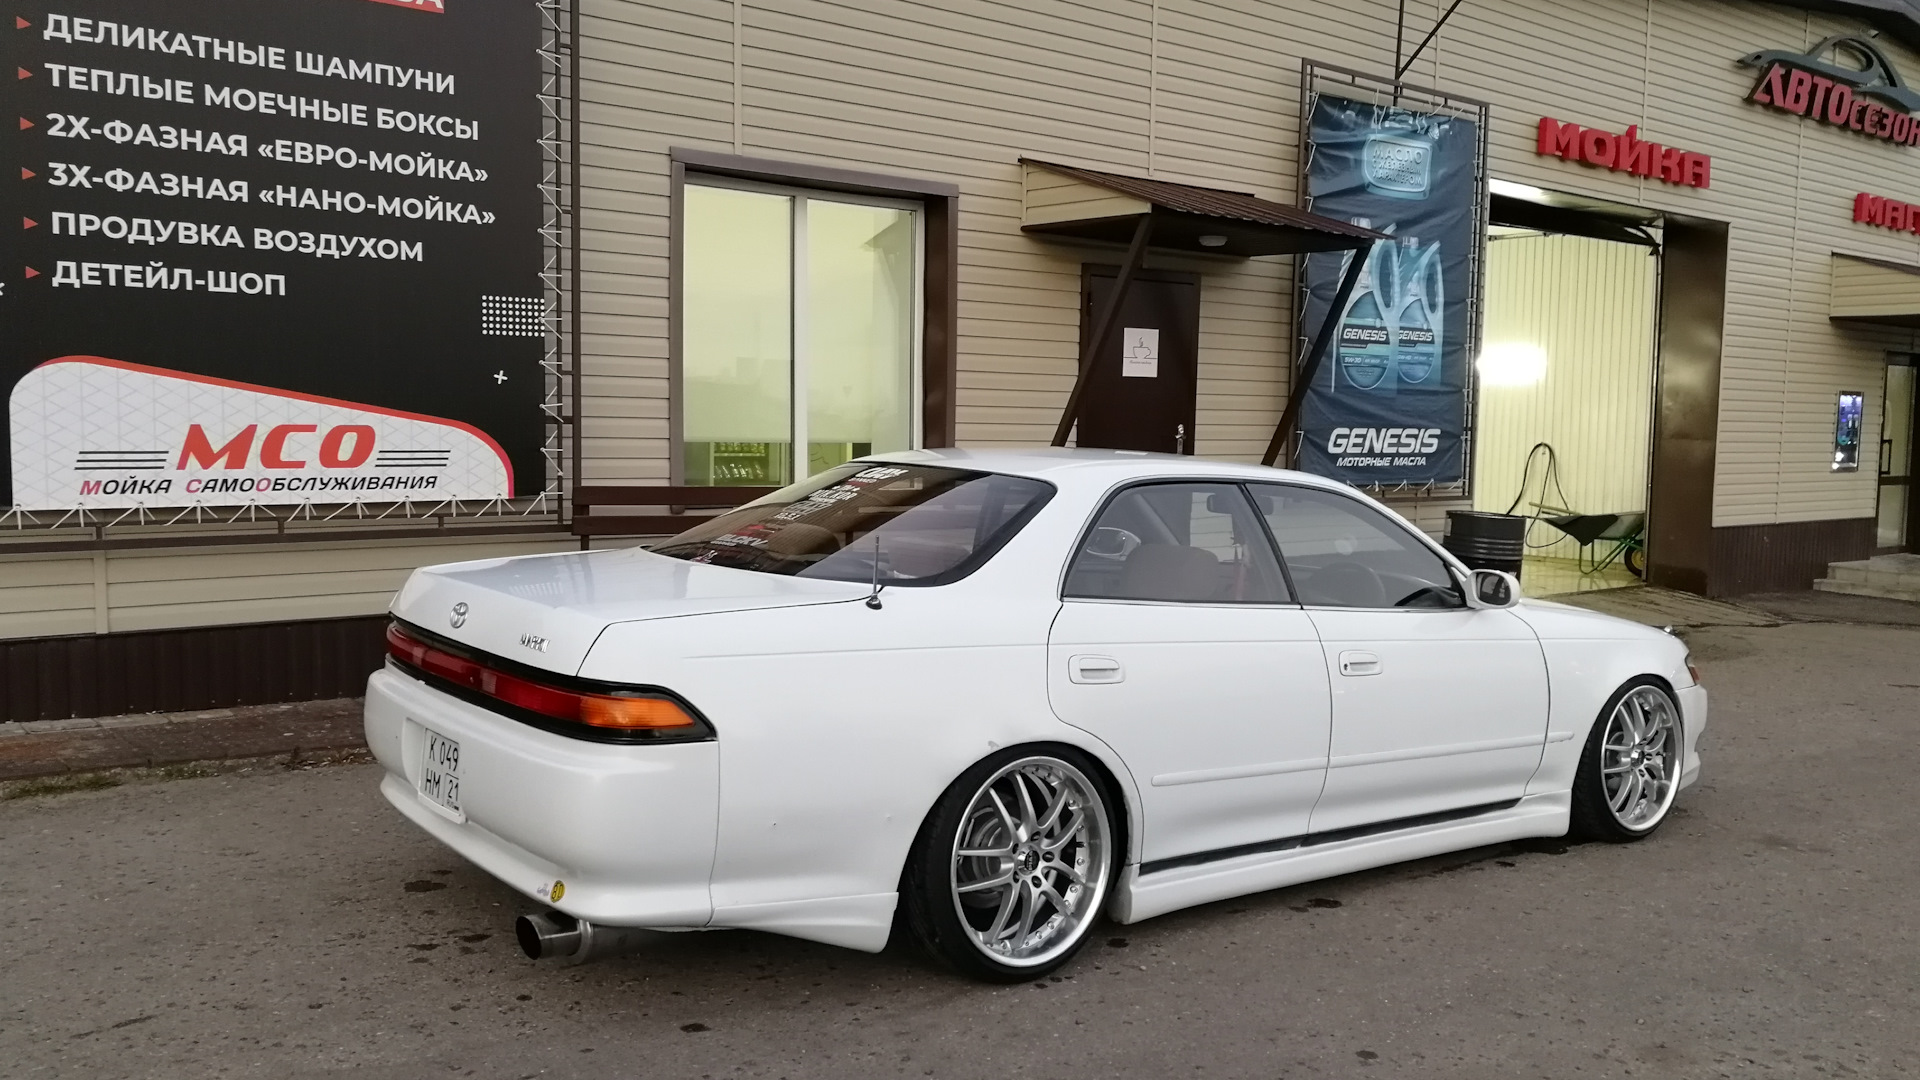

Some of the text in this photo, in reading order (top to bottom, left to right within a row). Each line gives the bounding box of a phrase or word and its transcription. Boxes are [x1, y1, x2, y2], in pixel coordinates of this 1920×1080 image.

[43, 13, 455, 95] ДЕЛИКАТНЫЕ ШАМПУНИ
[44, 63, 479, 141] ТЕПЛЫЕ МОЕЧНЫЕ БОКСЫ
[46, 113, 489, 182] 2Х-ФАЗНАЯ «ЕВРО-МОЙКА»
[1372, 144, 1423, 165] МАСЛО
[1537, 117, 1711, 189] МОЙКА
[48, 162, 496, 225] 3Х-ФАЗНАЯ «НАНО-МОЙКА»
[51, 211, 424, 263] ПРОДУВКА ВОЗДУХОМ
[52, 260, 286, 297] ДЕТЕЙЛ-ШОП
[1343, 328, 1388, 341] GENESIS
[176, 423, 377, 471] МСО
[1327, 427, 1441, 454] GENESIS
[1336, 456, 1426, 467] МОТОРНЫЕ МАСЛА
[80, 474, 438, 496] МОЙКА САМООБСЛУЖИВАНИЯ
[440, 741, 459, 772] 049
[447, 779, 459, 801] 21
